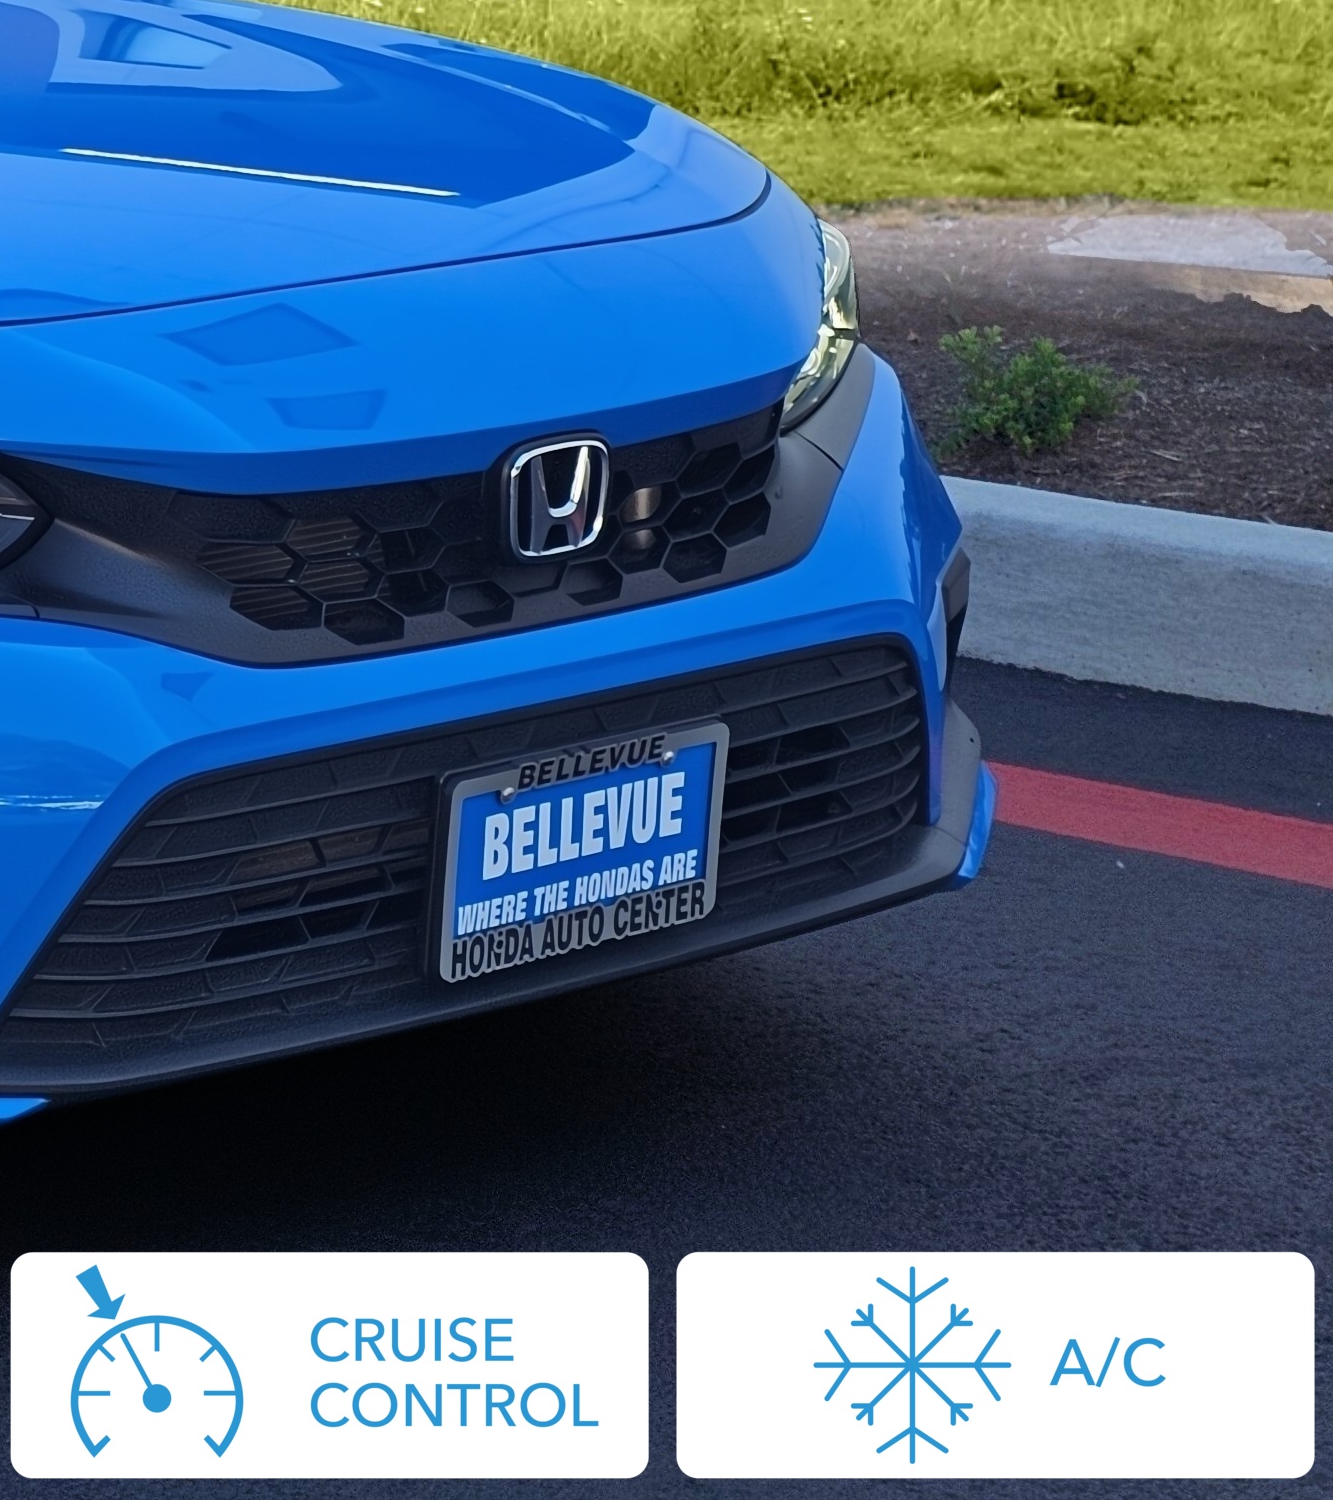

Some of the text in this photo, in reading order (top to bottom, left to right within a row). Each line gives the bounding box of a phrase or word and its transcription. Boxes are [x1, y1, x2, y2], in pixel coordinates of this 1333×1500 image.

[518, 735, 666, 789] BELLEVUE
[483, 771, 686, 880] BELLEVUE
[451, 881, 706, 979] HONDA AUTO CENTER
[458, 849, 698, 935] WHERE THE HONDAS ARE
